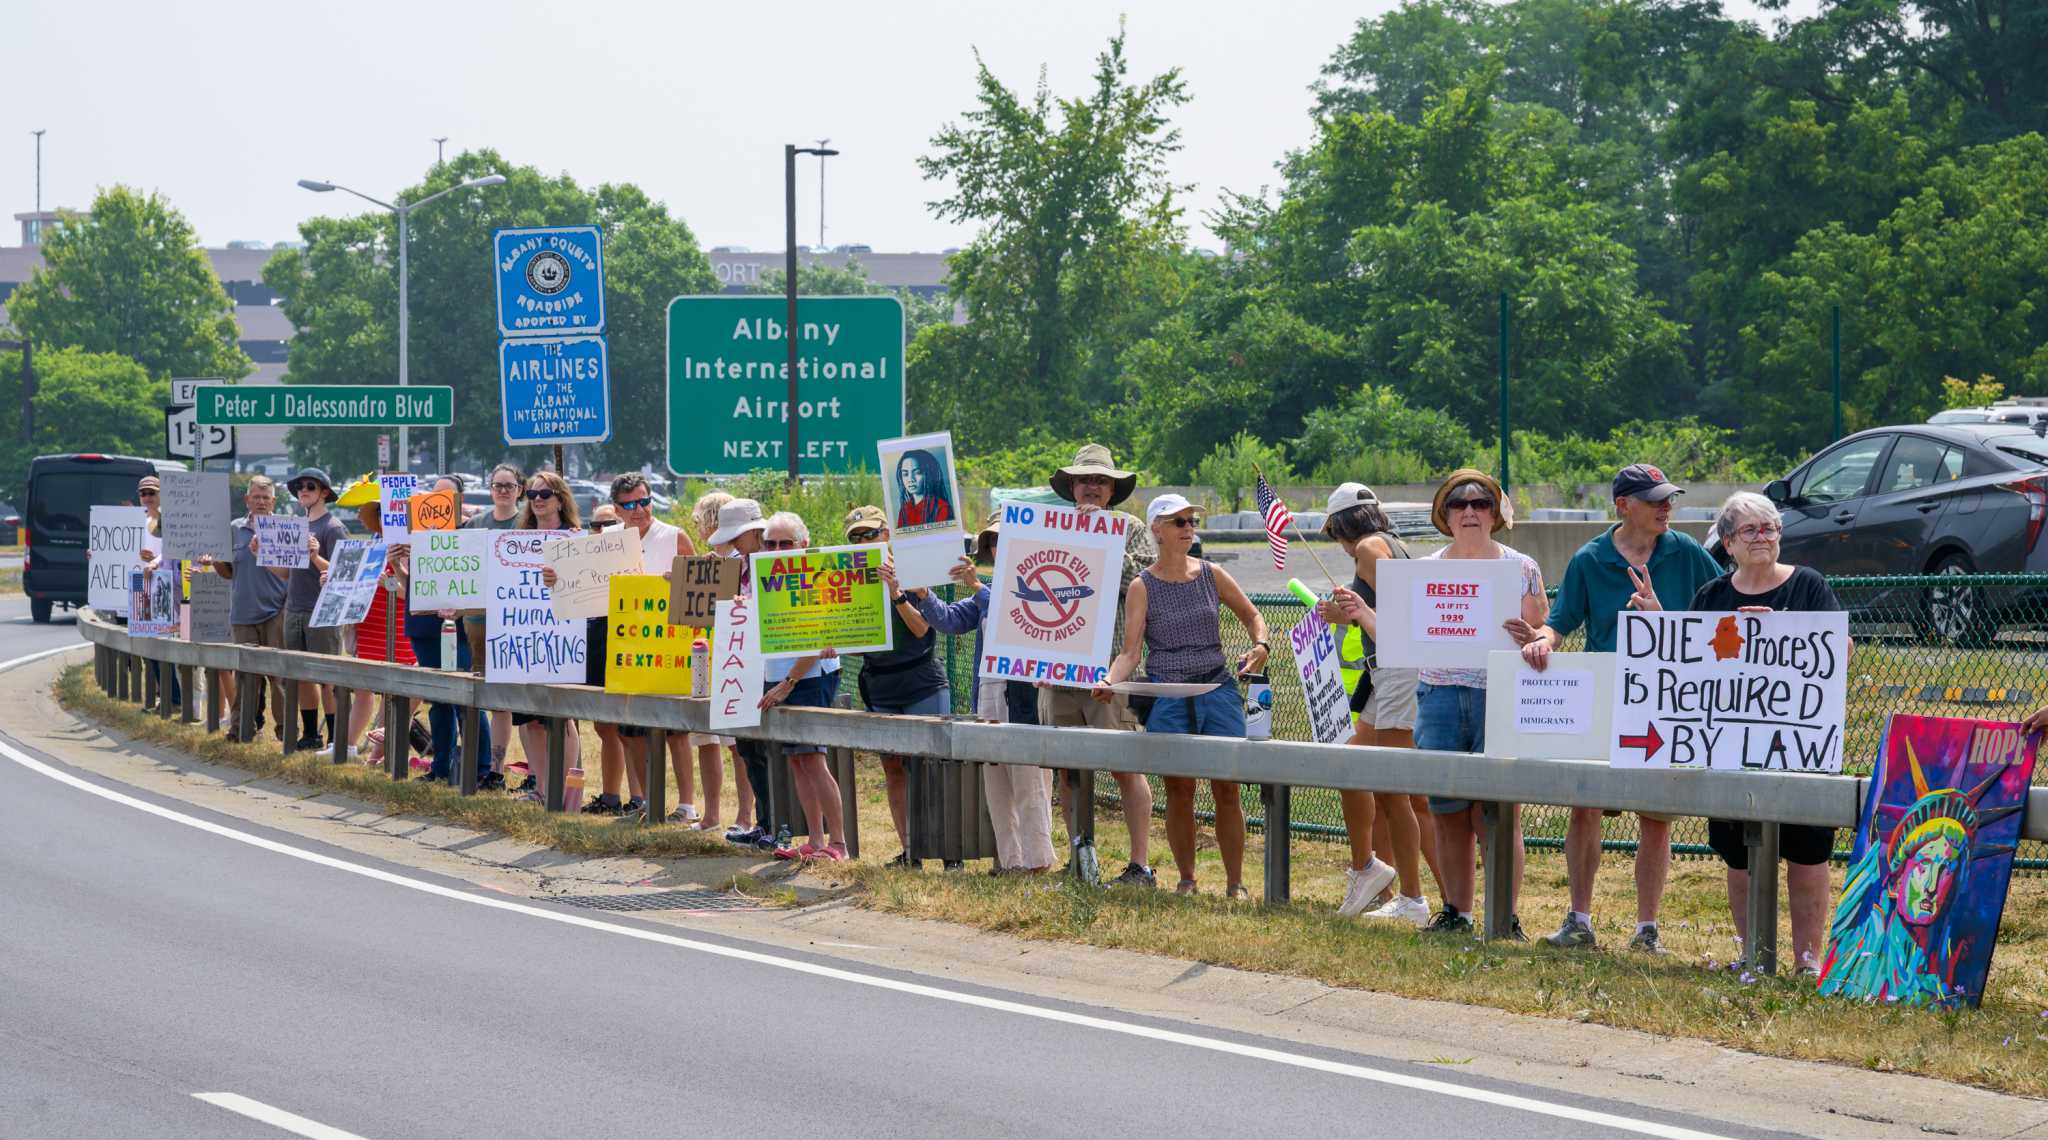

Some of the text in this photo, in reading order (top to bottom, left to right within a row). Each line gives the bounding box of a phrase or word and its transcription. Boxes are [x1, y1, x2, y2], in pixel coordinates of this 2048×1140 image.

[501, 236, 595, 272] ALBANY COUNTY
[718, 263, 760, 282] ORT
[517, 291, 583, 314] ROADSIDE
[515, 314, 587, 328] ADOPTED BY
[543, 343, 563, 356] THE
[509, 358, 599, 382] AIRLINES
[685, 357, 886, 379] International
[536, 382, 573, 394] OF THE
[214, 394, 433, 418] Peter J Dalessondro Blvd
[534, 395, 576, 408] ALBANY
[513, 408, 598, 421] INTERNATIONAL
[175, 421, 226, 445] 155
[533, 421, 580, 434] AIRPORT
[723, 441, 783, 458] NEXT
[381, 476, 416, 488] PEOPLE
[391, 488, 411, 499] ARE
[384, 514, 407, 526] CAR
[420, 504, 450, 521] AVELO
[1006, 506, 1126, 536] NO HUMAN
[257, 516, 275, 529] What
[91, 525, 145, 552] BOYCOTT
[277, 530, 301, 544] NOW
[431, 535, 459, 551] DUE
[506, 535, 548, 555] ave
[276, 555, 301, 566] THEN
[418, 556, 480, 574] PROCESS
[770, 551, 868, 576] ALL ARE
[1016, 550, 1091, 583] BOYCOTT EVIL
[90, 563, 141, 590] AVEL
[519, 570, 544, 586] IT
[686, 560, 721, 585] FIRE
[760, 567, 879, 593] WELCOME
[415, 579, 478, 597] FOR ALL
[497, 586, 550, 600] CALLE
[790, 587, 852, 607] HERE
[1055, 587, 1081, 599] avelo
[1426, 583, 1479, 596] RESIST
[685, 591, 716, 617] ICE
[503, 607, 562, 627] HUMA
[1010, 607, 1087, 642] BOYCOTT AVELO
[1440, 614, 1464, 622] 1939
[1427, 626, 1477, 636] GERMANY
[487, 630, 586, 673] TRAFFICKING
[1303, 624, 1334, 680] on ICE
[1625, 615, 1835, 680] DUE Process
[721, 604, 748, 715] SHAME
[985, 655, 1108, 685] TRAFFICKING
[1521, 679, 1580, 687] PROTECT THE
[1623, 667, 1648, 705] is
[1521, 698, 1566, 706] RIGHTS OF
[1520, 717, 1575, 725] IMMIGRANTS
[1670, 724, 1839, 769] BY LAW!
[1968, 727, 2026, 766] HOPE
